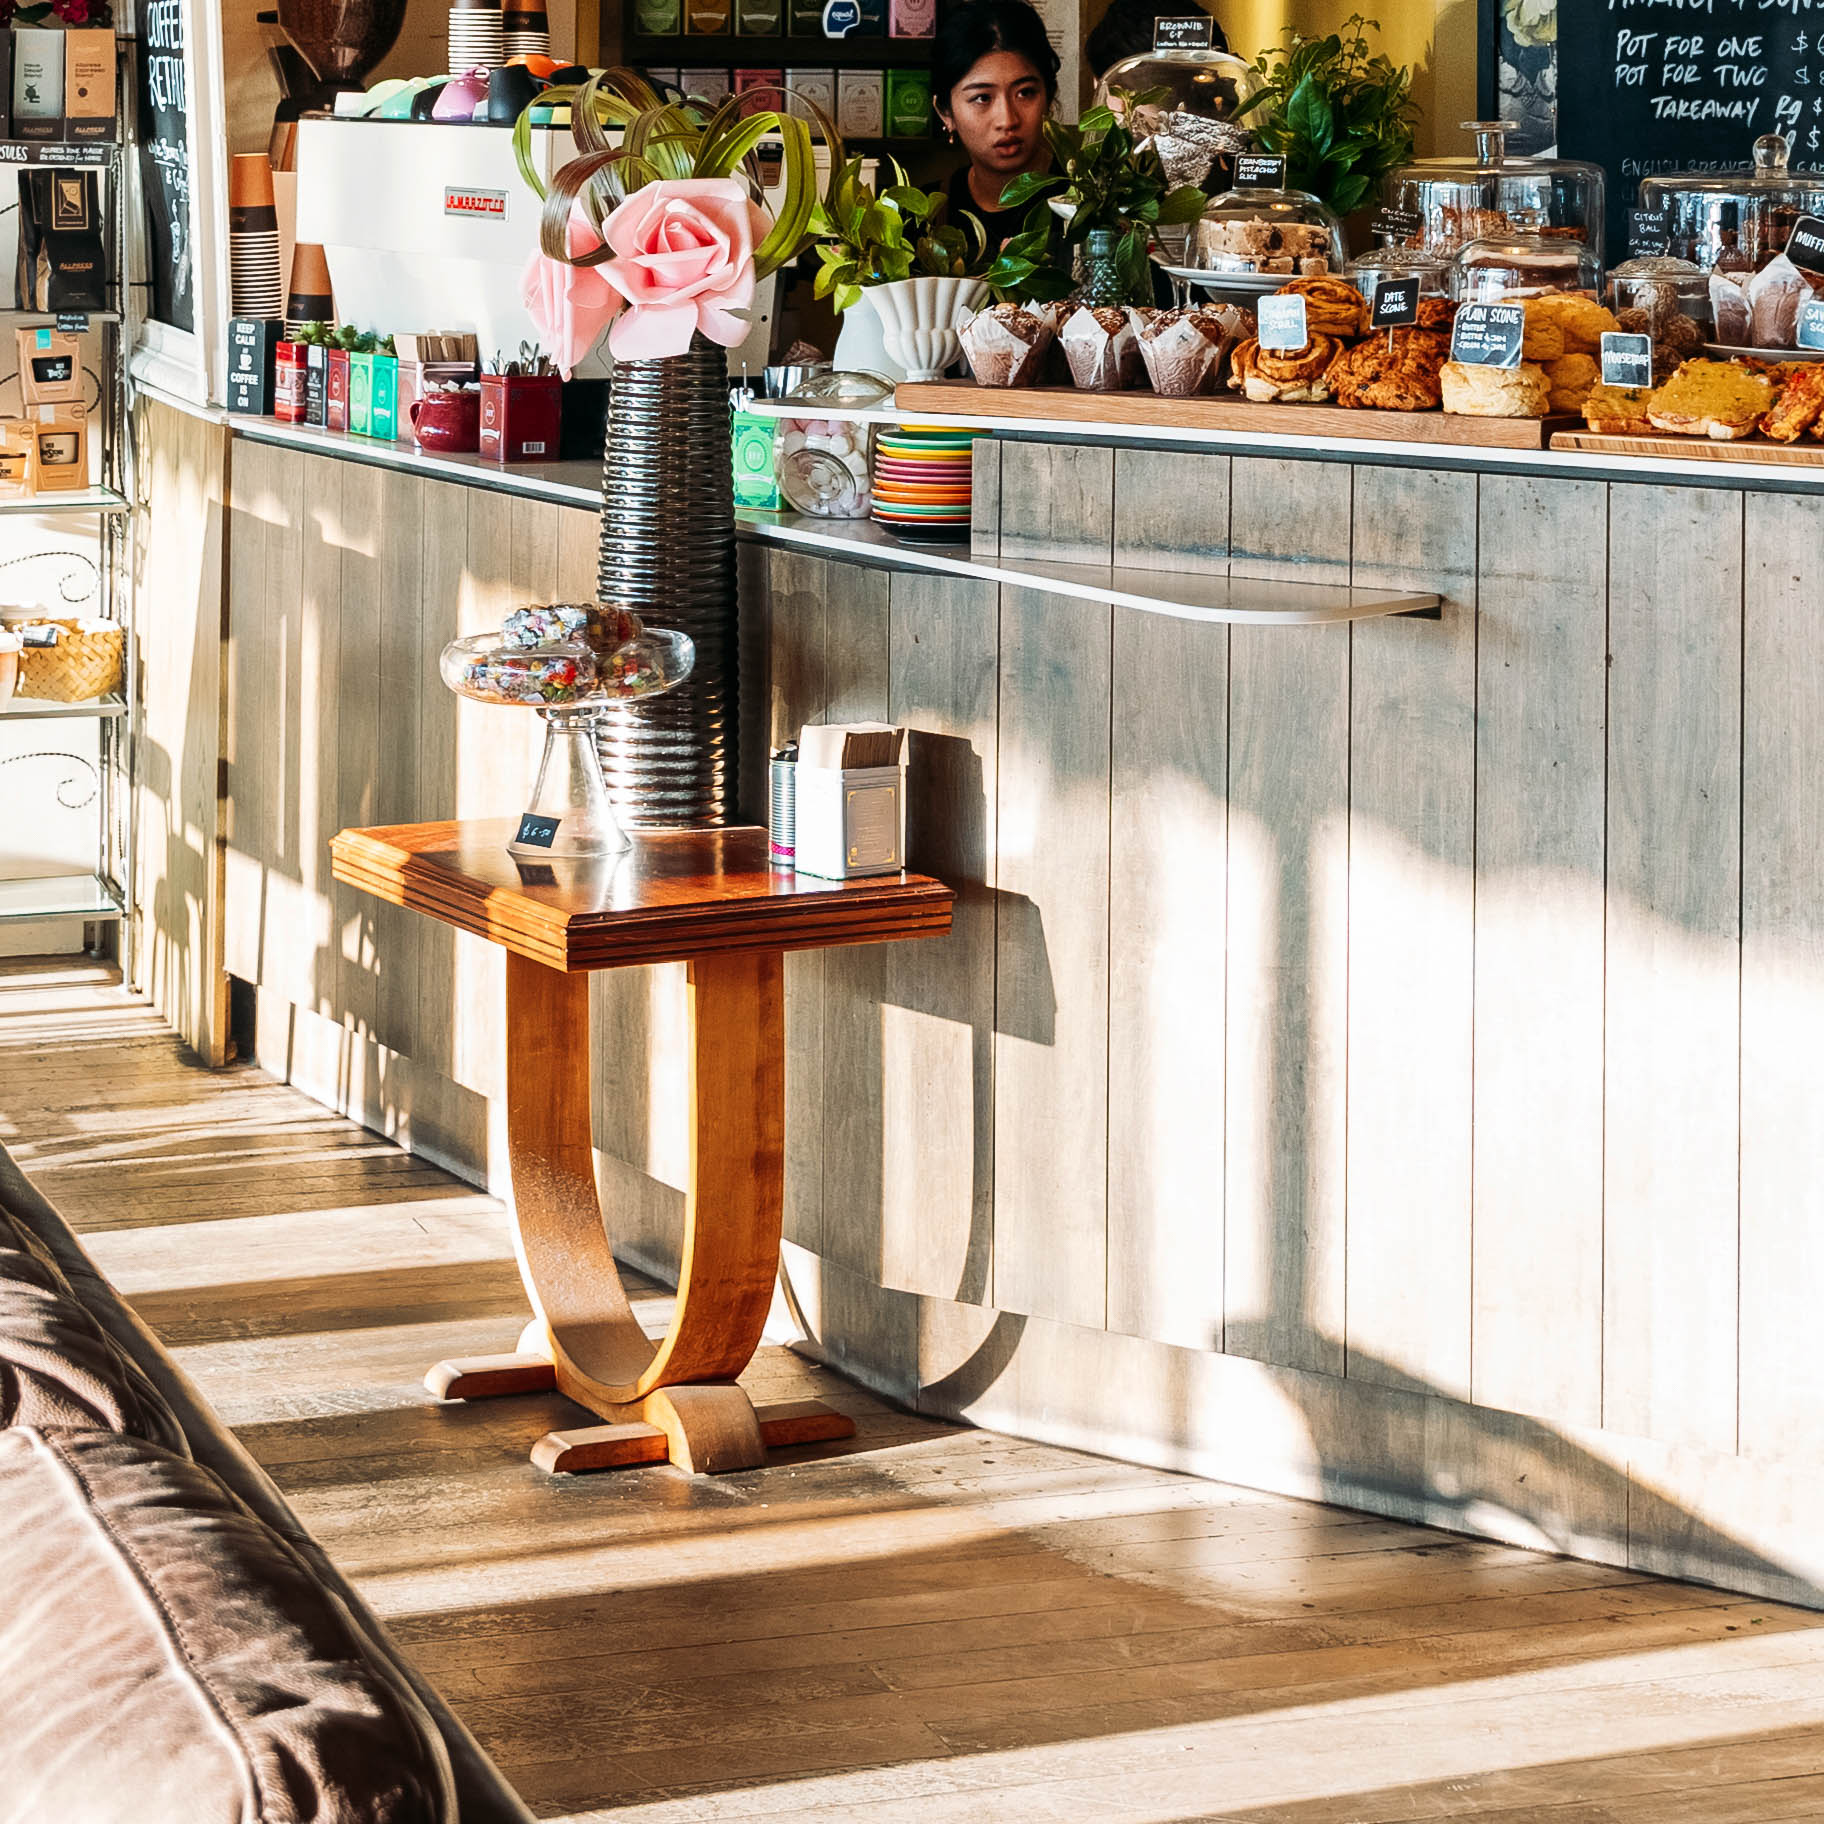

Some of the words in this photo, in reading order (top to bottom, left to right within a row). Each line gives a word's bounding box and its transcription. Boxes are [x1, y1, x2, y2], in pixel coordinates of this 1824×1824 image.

[1616, 30, 1657, 62] POT
[1665, 35, 1704, 58] FOR
[1717, 35, 1763, 57] ONE
[1651, 96, 1760, 126] TAKEAWAY
[1380, 302, 1408, 314] SCONE
[1460, 307, 1487, 322] PLAIN
[1490, 308, 1520, 324] SCONE
